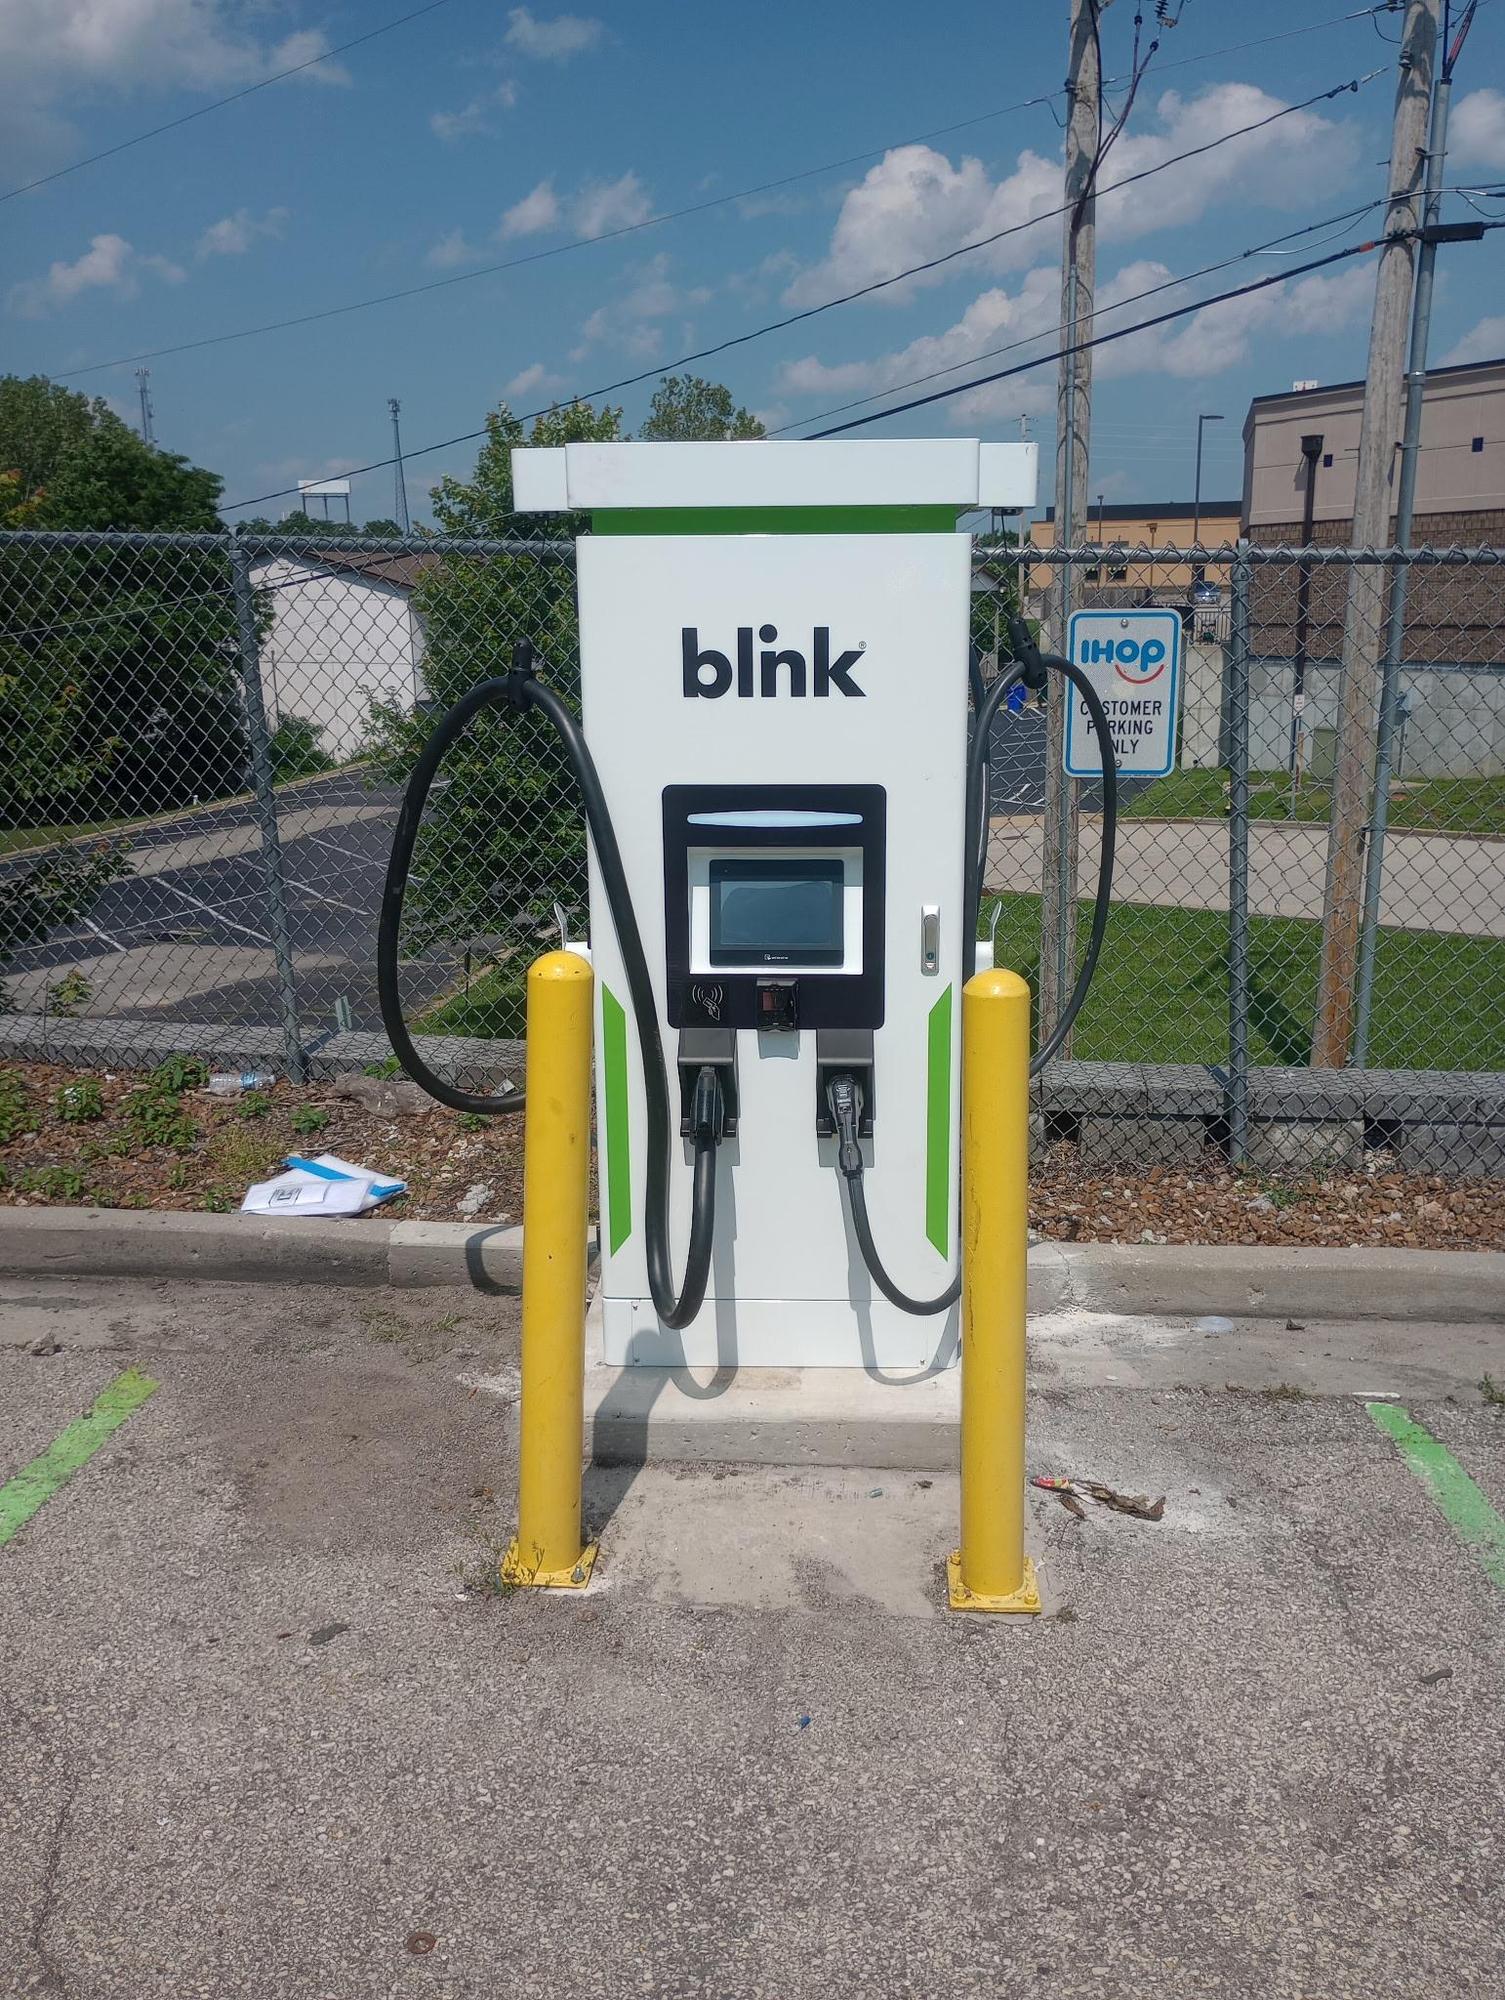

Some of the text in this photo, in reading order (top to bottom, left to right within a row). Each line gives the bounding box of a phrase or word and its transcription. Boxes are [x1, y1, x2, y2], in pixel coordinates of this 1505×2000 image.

[1080, 700, 1162, 716] CSTOMER
[1087, 719, 1153, 735] PRKING
[1111, 739, 1140, 754] NLY
